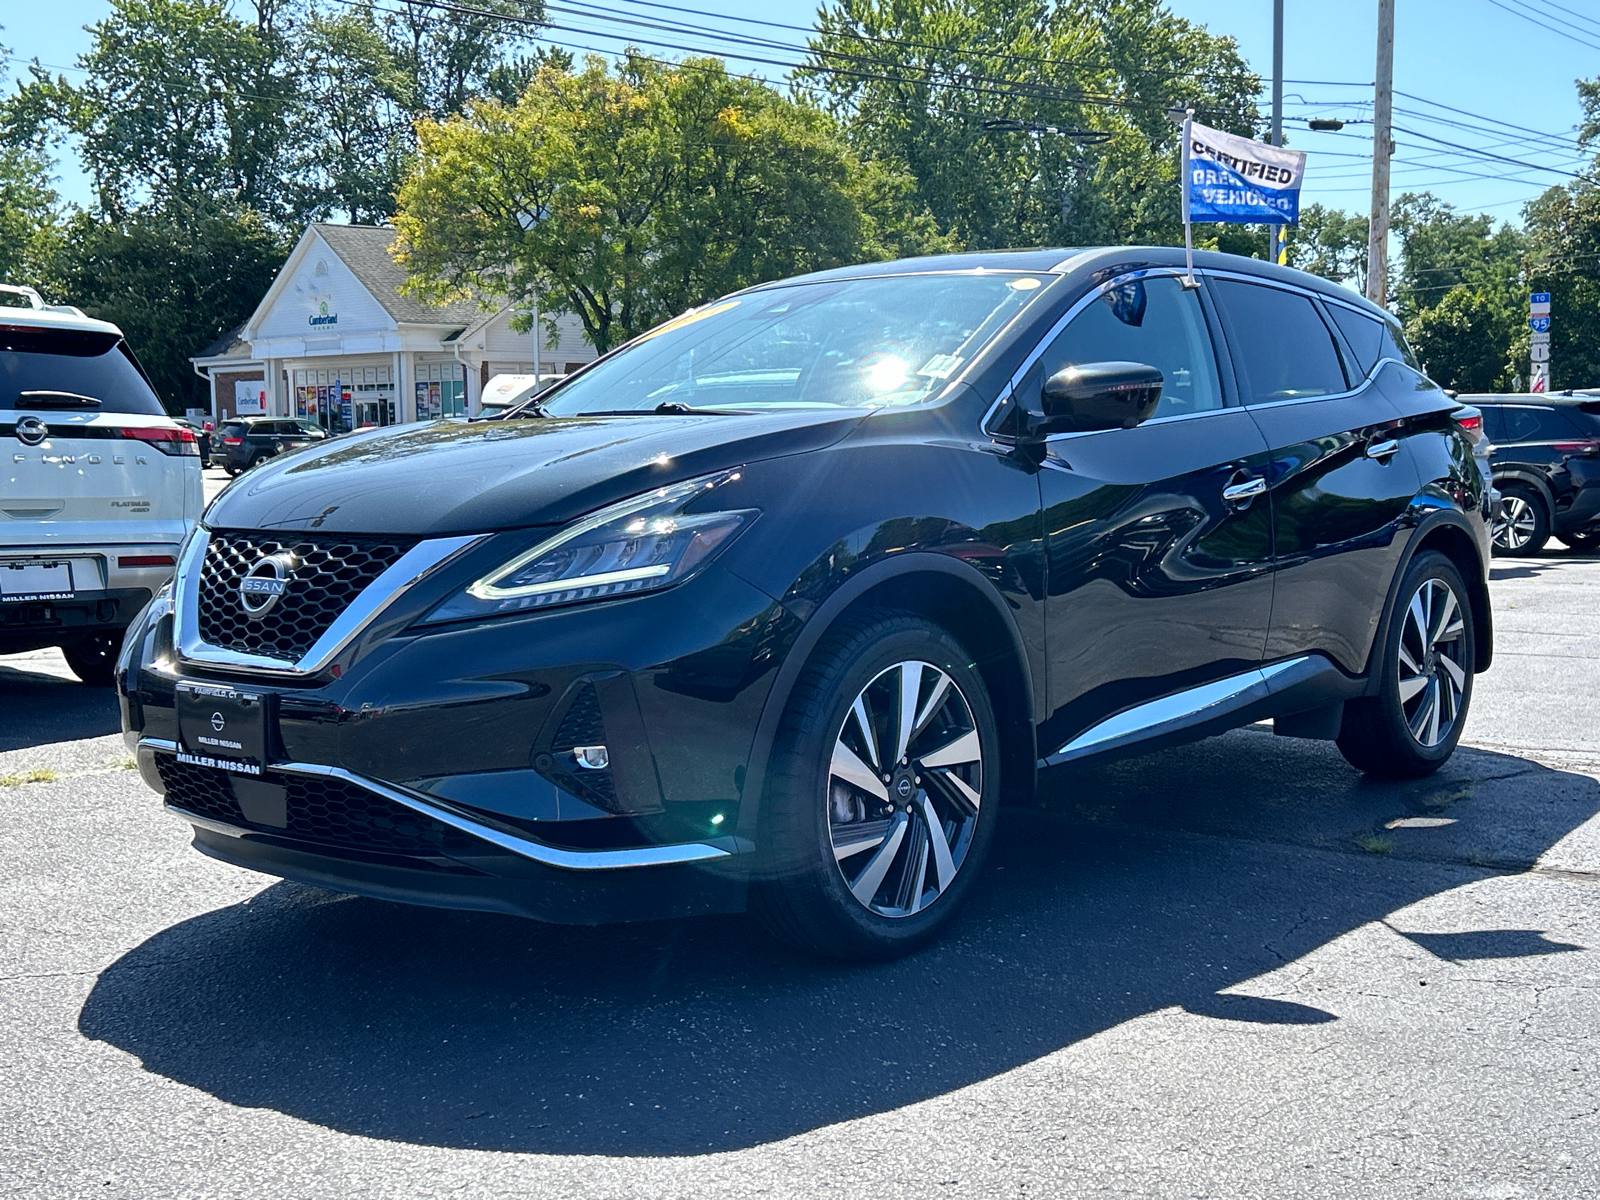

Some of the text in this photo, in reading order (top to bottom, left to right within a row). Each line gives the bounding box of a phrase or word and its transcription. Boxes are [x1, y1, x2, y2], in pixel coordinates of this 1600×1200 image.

[1192, 141, 1292, 184] CERTIFIED
[309, 314, 337, 325] Cumberland
[1533, 320, 1547, 329] 95
[238, 397, 258, 405] Cumberland
[243, 580, 284, 592] SSAN
[228, 691, 237, 699] CT
[198, 736, 242, 749] MILLER NISSAN
[176, 753, 260, 775] MILLER NISSAN
